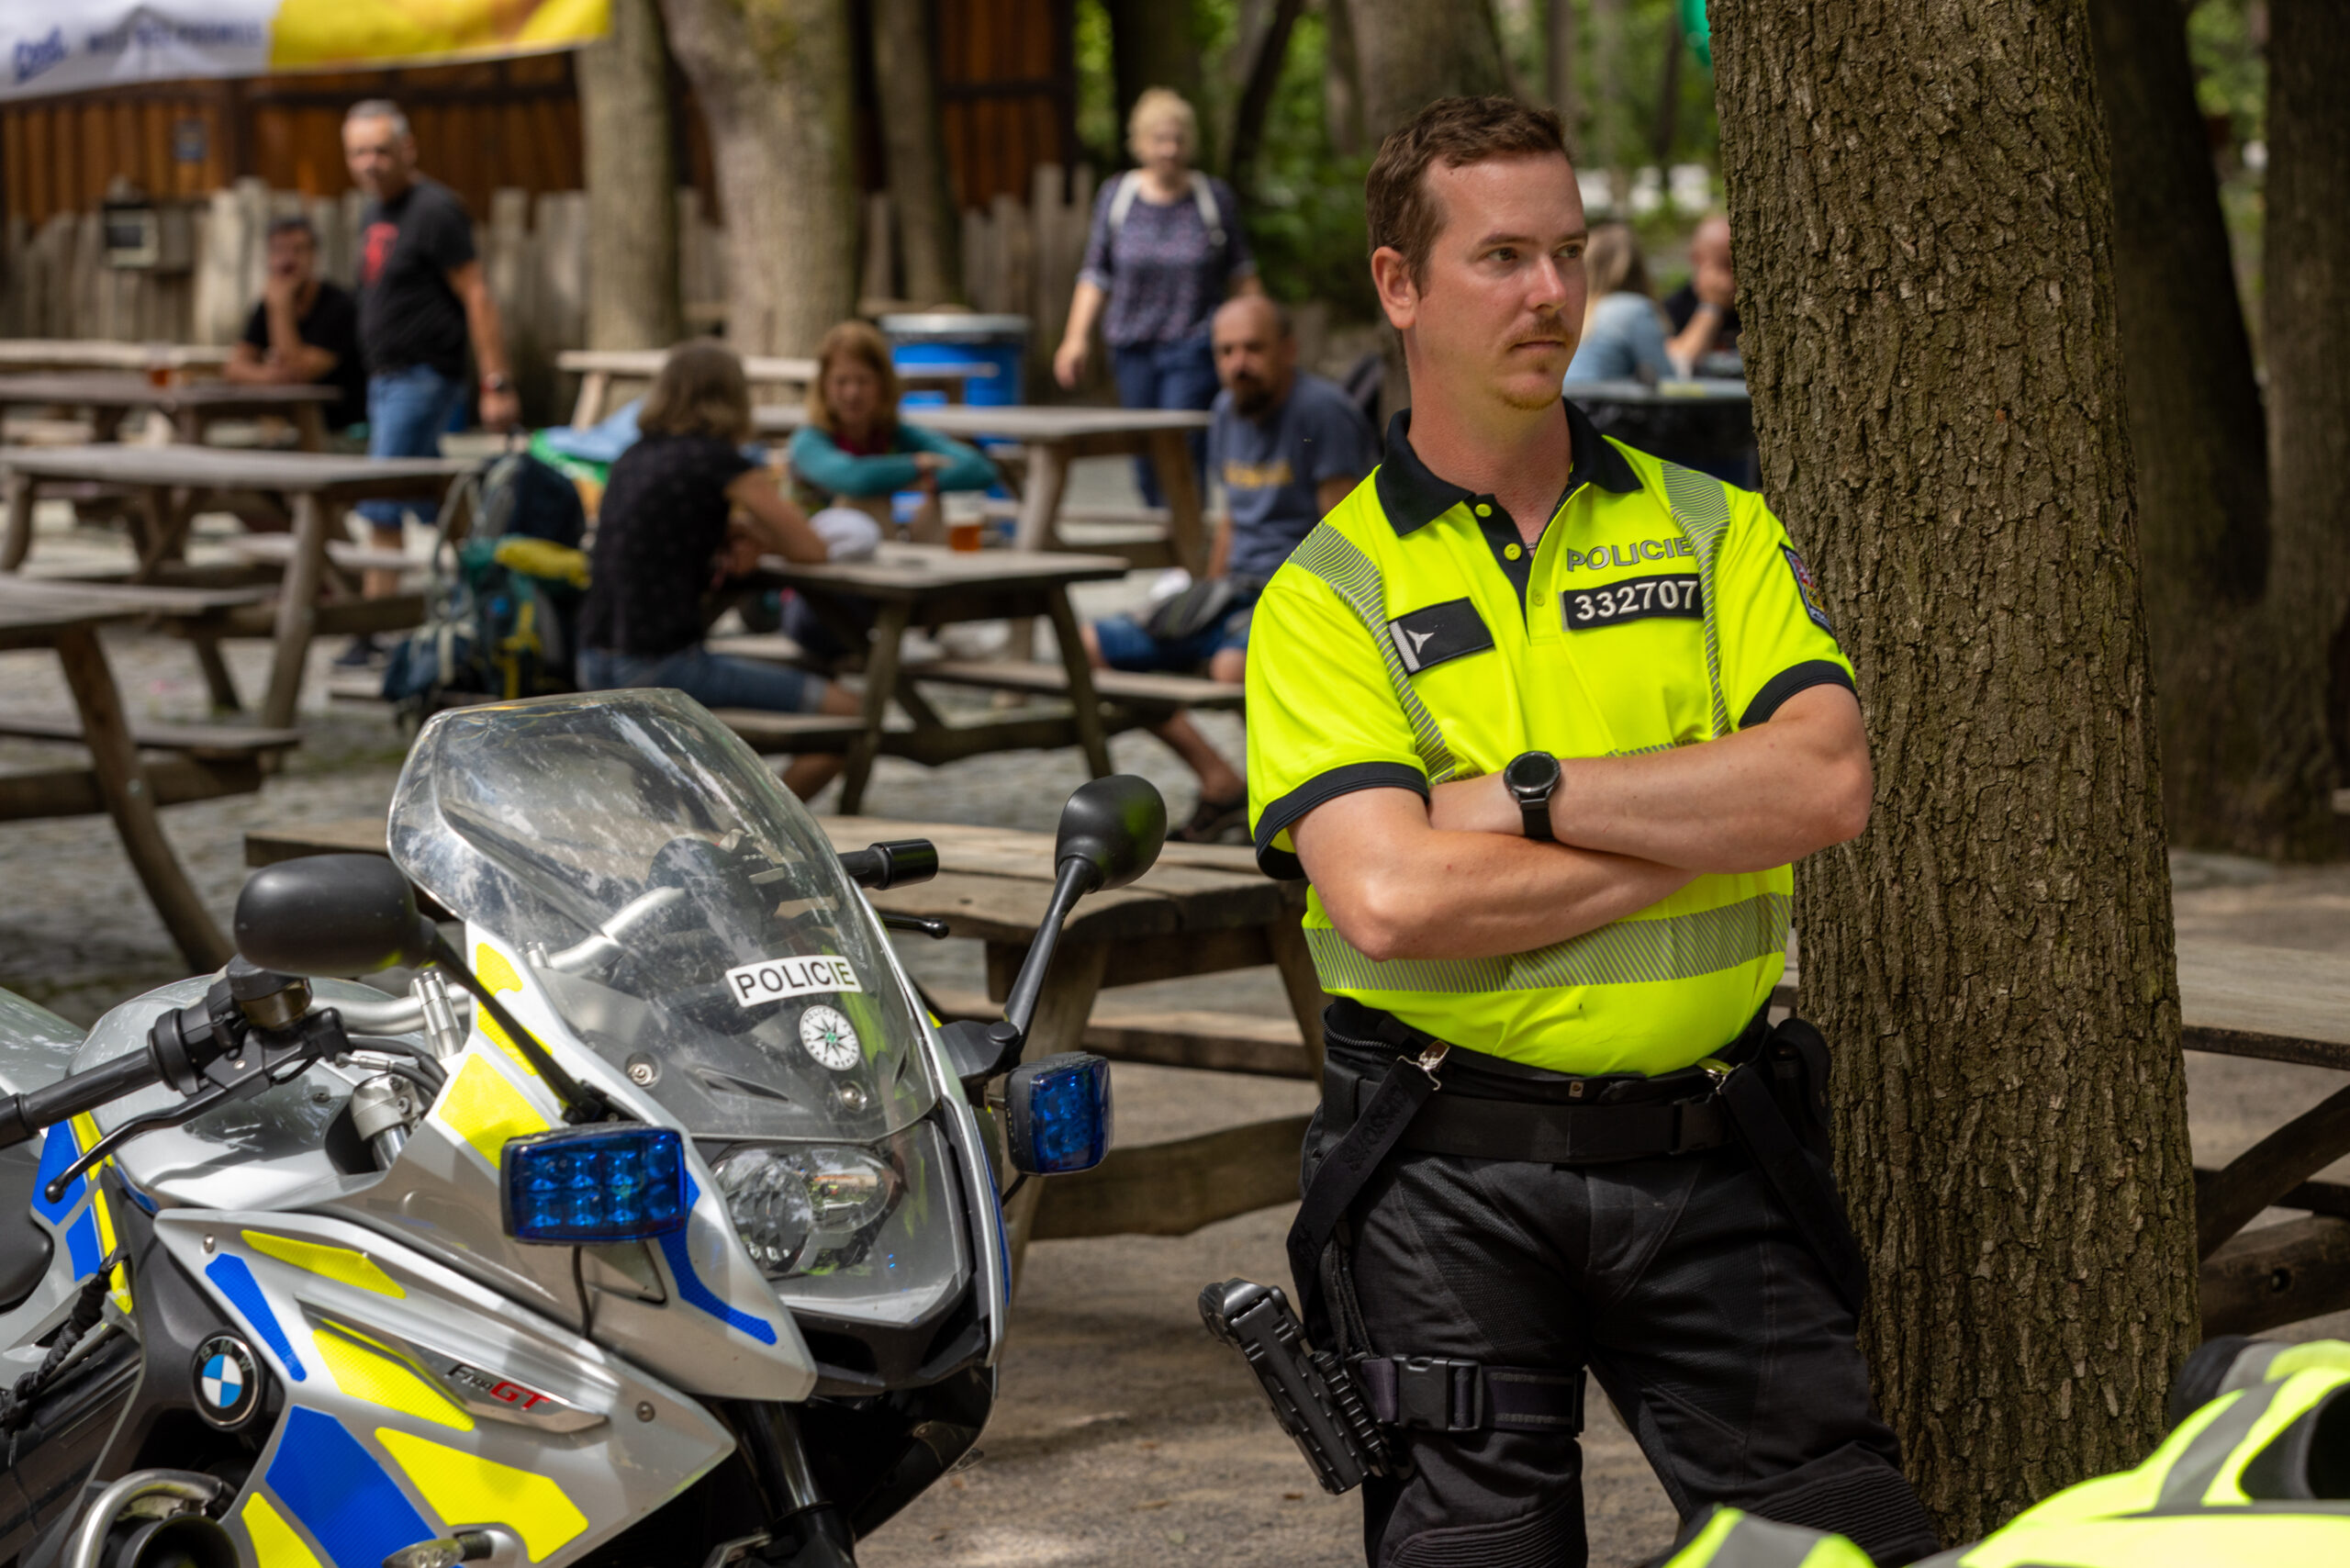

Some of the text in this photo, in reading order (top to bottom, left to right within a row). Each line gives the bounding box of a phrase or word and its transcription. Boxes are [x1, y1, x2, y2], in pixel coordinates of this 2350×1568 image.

[1566, 536, 1695, 572] POLICIE
[1574, 580, 1698, 621] 332707
[735, 961, 855, 999] POLICIE
[199, 1339, 253, 1372] BMW
[489, 1381, 552, 1411] GT
